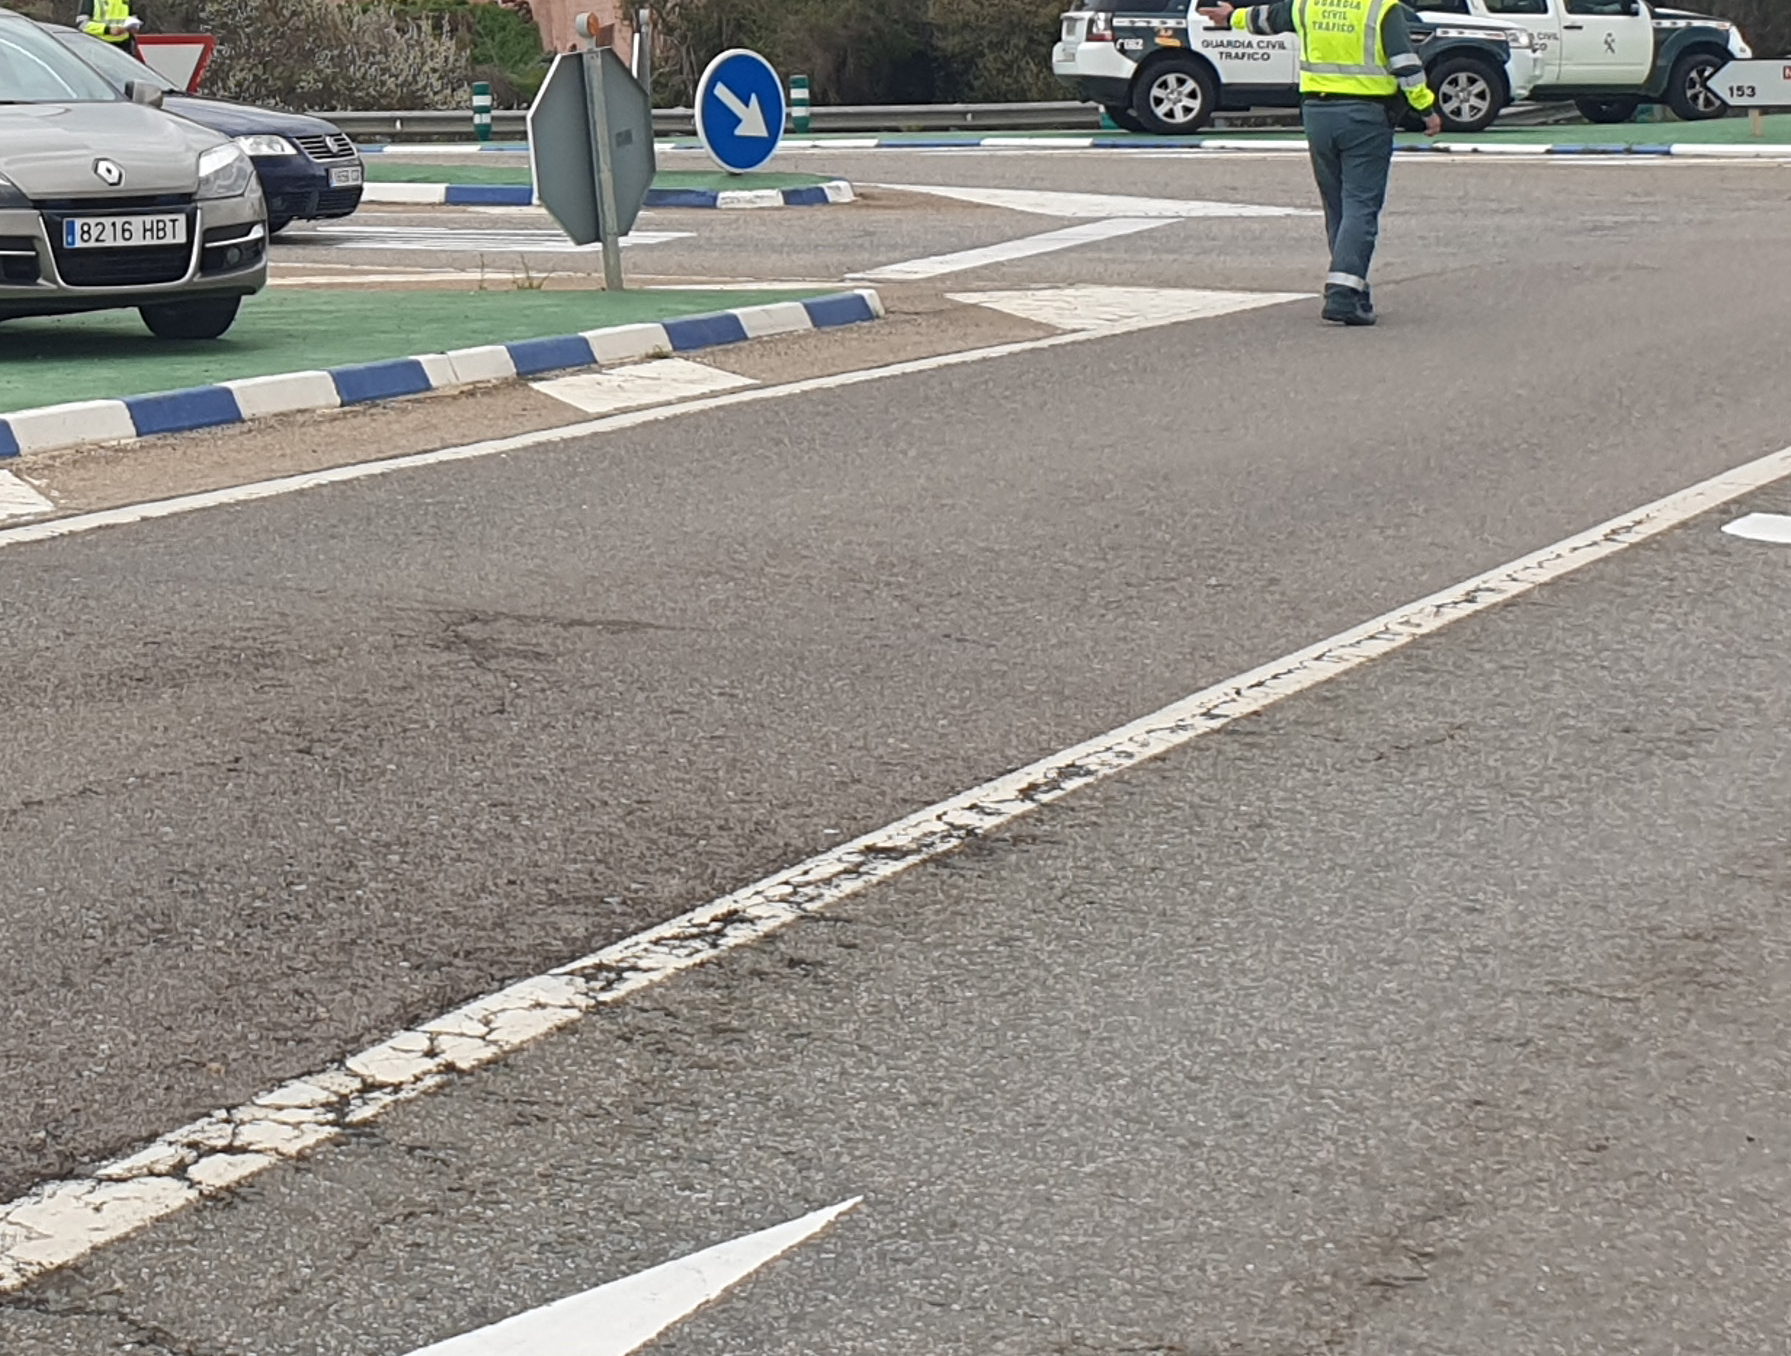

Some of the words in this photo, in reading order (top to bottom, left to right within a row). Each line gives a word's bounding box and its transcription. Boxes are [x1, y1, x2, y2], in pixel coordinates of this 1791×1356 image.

[1321, 9, 1347, 20] CIVIL
[1311, 20, 1355, 33] TRAFICO
[1201, 39, 1254, 49] GUARDIA
[1256, 40, 1286, 50] CIVIL
[1218, 51, 1271, 61] TRAFICO
[1728, 85, 1756, 98] 153
[80, 221, 133, 243] 8216
[142, 219, 179, 241] HBT
